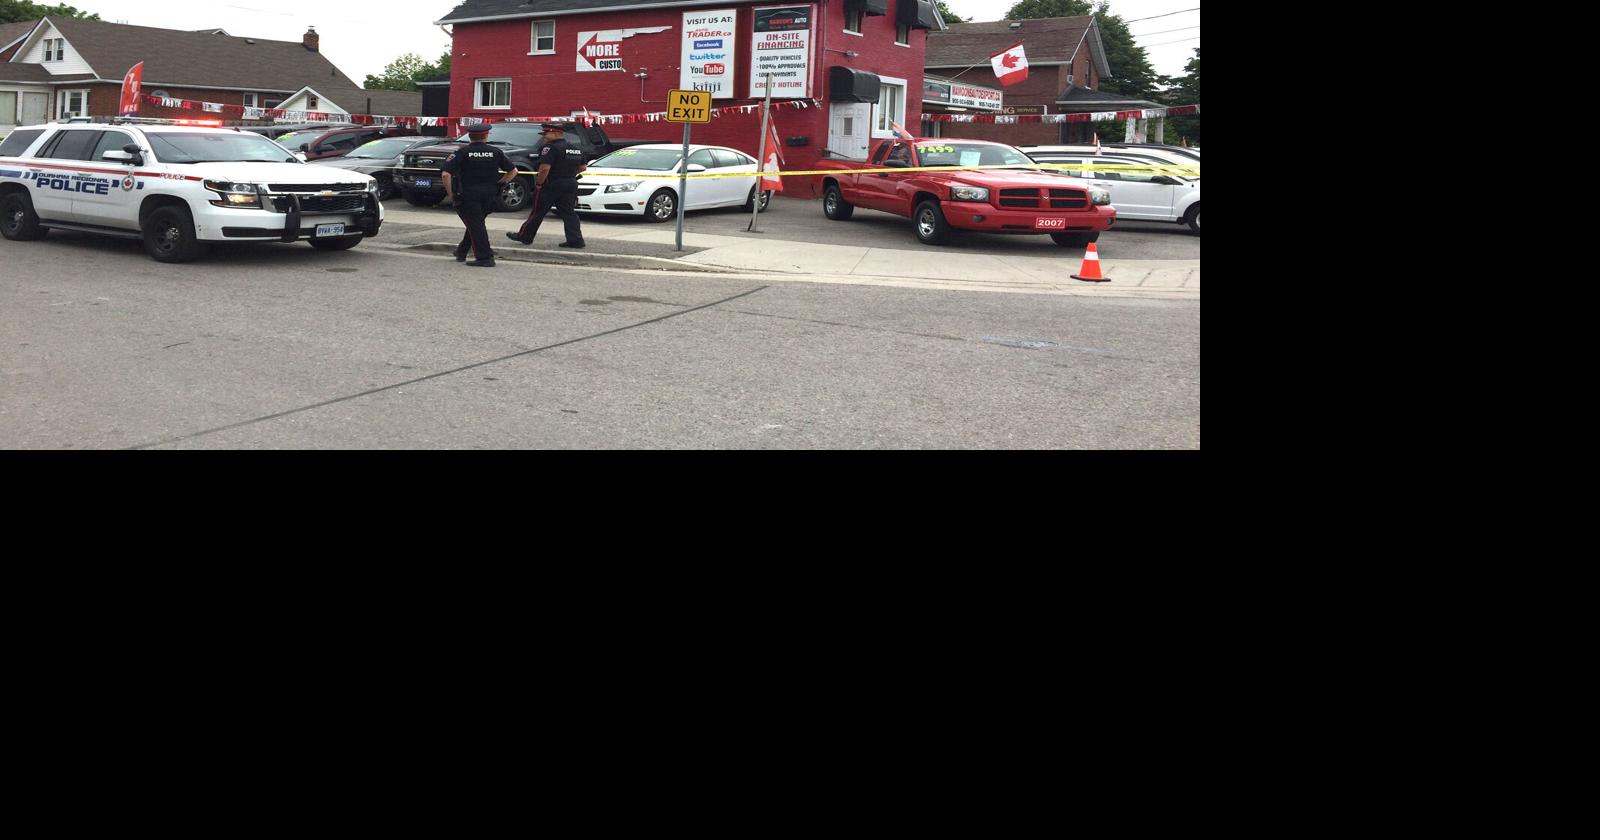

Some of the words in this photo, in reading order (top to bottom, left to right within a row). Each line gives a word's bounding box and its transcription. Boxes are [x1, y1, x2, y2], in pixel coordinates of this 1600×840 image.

[766, 33, 800, 41] ON-SITE
[757, 41, 804, 49] FINANCING
[586, 44, 620, 57] MORE
[599, 59, 622, 69] CUSTO
[693, 82, 721, 92] kijiji
[680, 95, 699, 105] NO
[673, 108, 704, 118] EXIT
[38, 172, 70, 180] DURHAM
[71, 175, 109, 183] REGIONAL
[159, 172, 186, 180] POLICE
[36, 178, 109, 195] POLICE
[1038, 219, 1063, 227] 2007
